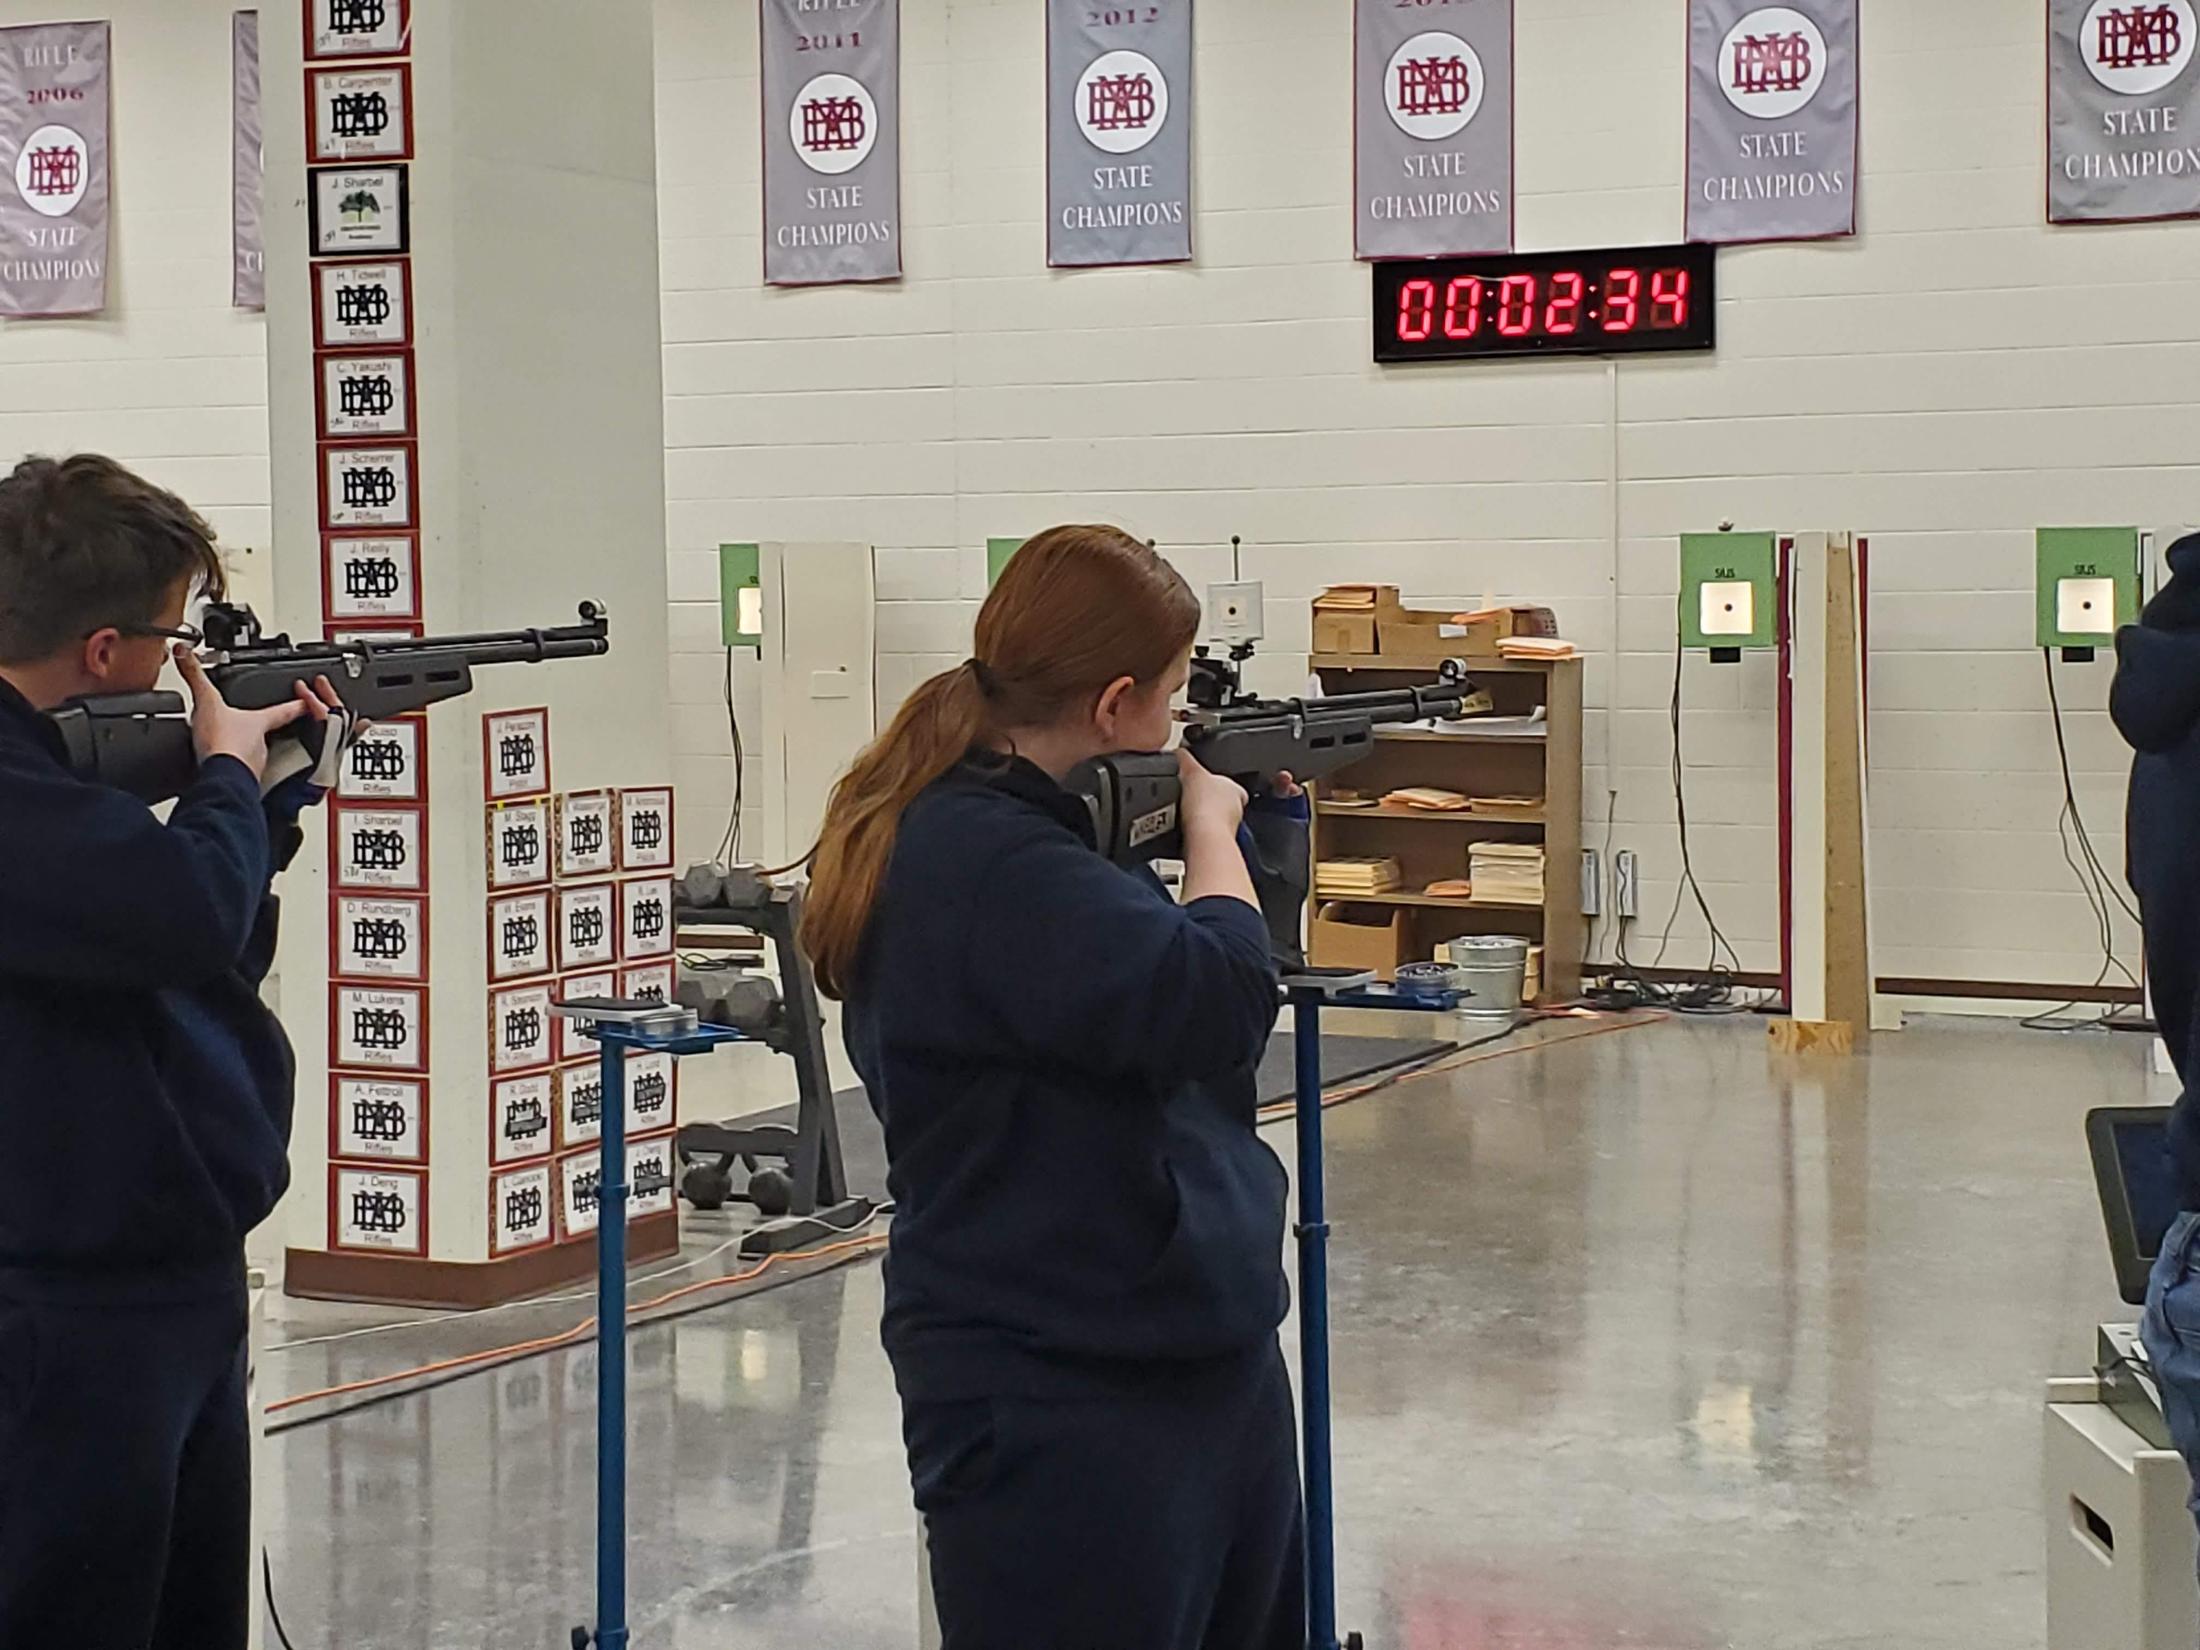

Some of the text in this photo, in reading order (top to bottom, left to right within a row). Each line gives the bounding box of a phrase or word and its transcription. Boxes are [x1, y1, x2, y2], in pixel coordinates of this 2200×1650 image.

[1085, 6, 1159, 27] 2012
[795, 31, 860, 51] 2011
[26, 87, 85, 105] 2006
[2103, 107, 2178, 136] STATE
[1738, 131, 1809, 160] STATE
[1093, 165, 1154, 191] STATE
[1402, 151, 1468, 179] STATE
[806, 185, 864, 210] STATE
[1702, 171, 1847, 204] CHAMPIONS
[1061, 199, 1184, 231] CHAMPIONS
[1369, 190, 1502, 221] CHAMPIONS
[26, 226, 80, 247] STATE
[776, 220, 892, 248] CHAMPIONS
[2, 259, 102, 282] CHAMPIONS
[1397, 267, 1690, 342] 00:02:34
